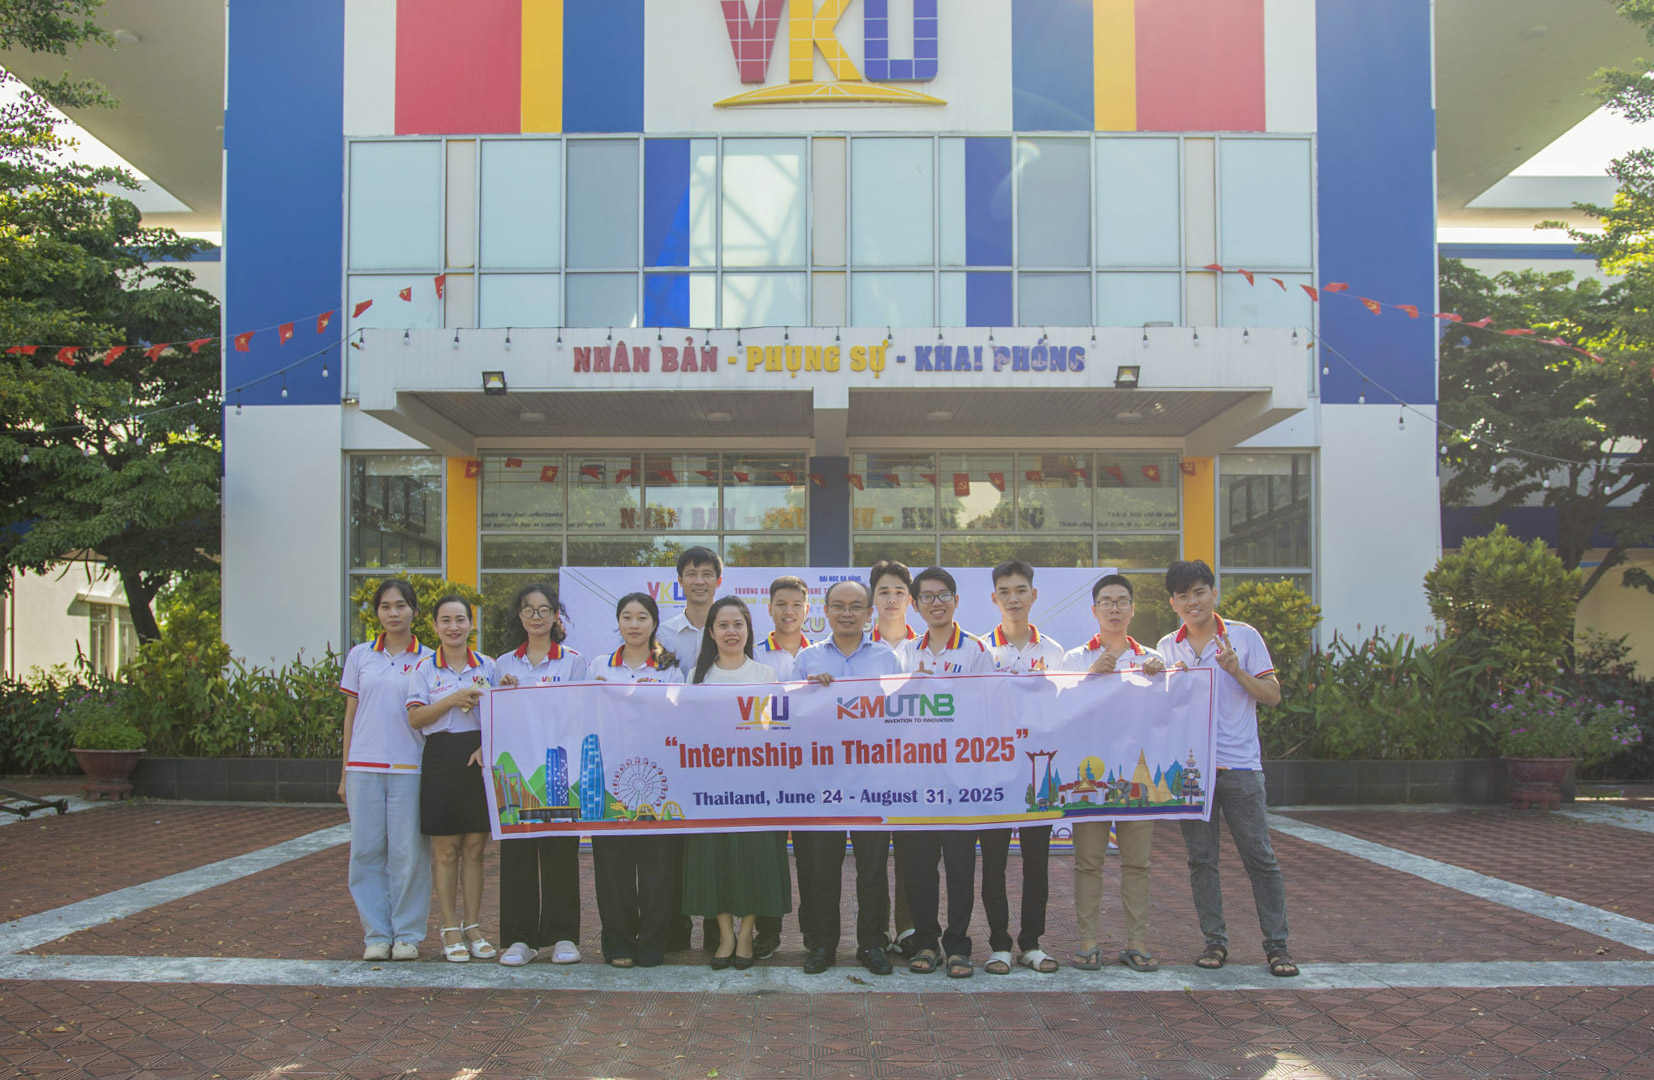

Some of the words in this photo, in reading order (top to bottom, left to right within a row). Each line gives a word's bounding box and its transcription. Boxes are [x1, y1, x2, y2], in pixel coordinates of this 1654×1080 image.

[720, 0, 938, 84] VKU
[573, 340, 650, 372] NHÂN
[661, 336, 718, 372] BẢN
[727, 356, 737, 365] -
[746, 345, 840, 378] PHỤNG
[850, 339, 889, 379] SỰ
[896, 355, 906, 364] -
[915, 346, 983, 372] KHAI
[993, 337, 1086, 373] PHÓNG
[737, 695, 789, 721] VKU
[837, 693, 955, 720] KMUTNB
[811, 741, 834, 766] in
[841, 738, 947, 765] Thailand
[692, 791, 770, 806] Thailand,
[776, 790, 815, 804] June
[822, 789, 842, 804] 24
[860, 788, 918, 806] August
[926, 789, 952, 804] 31,
[958, 787, 1004, 803] 2025
